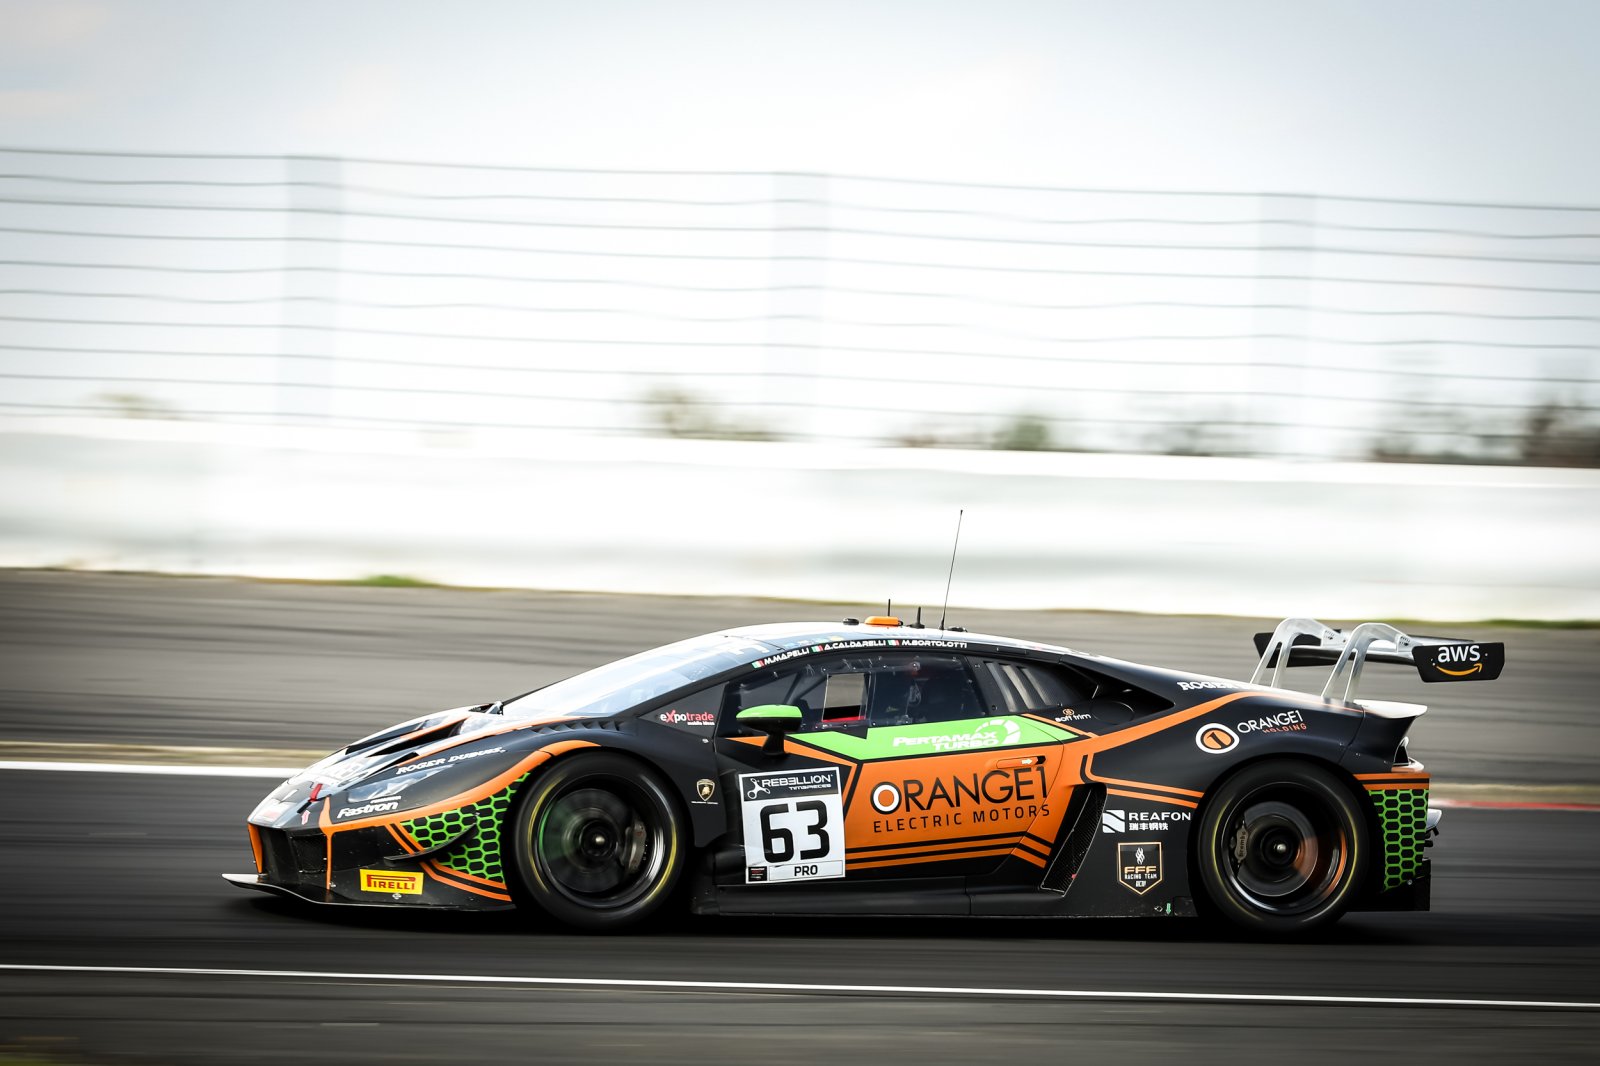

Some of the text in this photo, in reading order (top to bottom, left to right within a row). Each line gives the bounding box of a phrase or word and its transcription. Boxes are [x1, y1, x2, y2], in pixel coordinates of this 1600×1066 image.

[824, 639, 886, 651] A.CALDARELLI
[901, 639, 968, 649] M.BORTOLOTTI
[764, 647, 810, 666] M.MAPELLI
[1437, 645, 1481, 663] aws
[1237, 709, 1304, 733] ORANGE1
[1262, 723, 1307, 733] HOLDING
[893, 731, 997, 747] PERTAMAX
[933, 738, 999, 751] TURBO
[396, 758, 446, 774] ROGER
[870, 766, 1049, 815] ORANGE1
[337, 802, 398, 819] Fastron
[873, 804, 1050, 833] ELECTRIC MOTORS
[1128, 812, 1191, 821] REAFON
[760, 800, 830, 863] 63
[794, 865, 818, 876] PRO
[366, 874, 416, 890] PIRELLI
